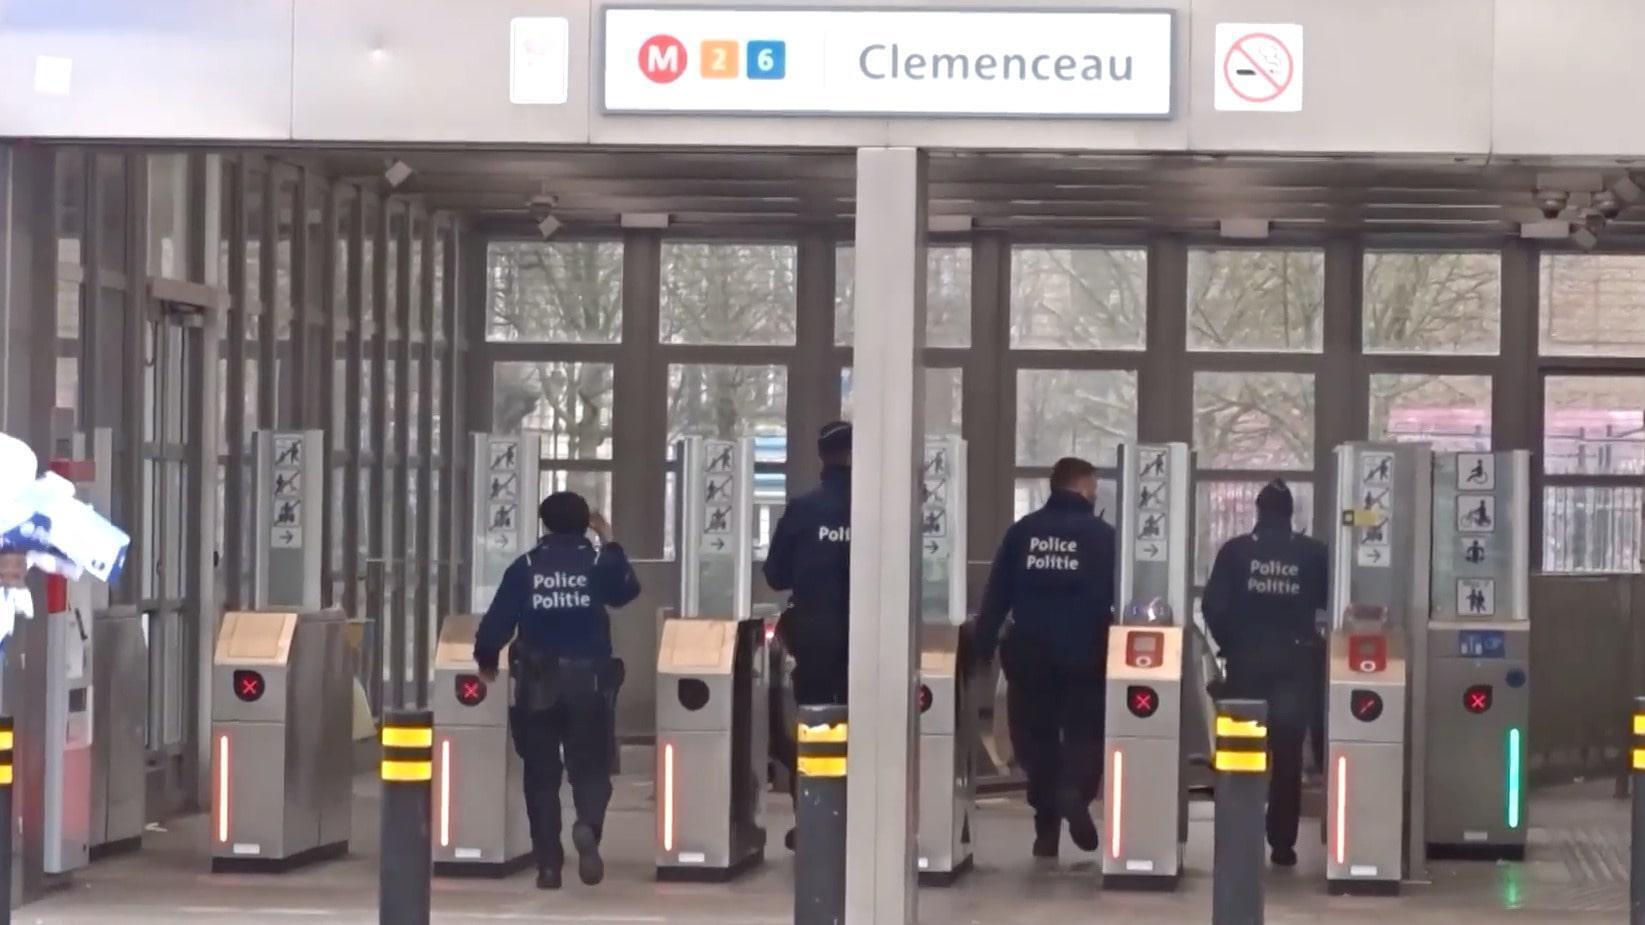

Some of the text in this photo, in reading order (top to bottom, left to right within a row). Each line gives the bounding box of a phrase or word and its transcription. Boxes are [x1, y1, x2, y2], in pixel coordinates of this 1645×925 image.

[648, 43, 1133, 81] M 2 6 Clemenceau
[1029, 536, 1078, 553] Police
[1026, 554, 1080, 571] Politie
[1250, 559, 1299, 576] Police
[533, 571, 588, 590] Police
[1247, 577, 1301, 594] Politie
[532, 590, 591, 610] Politie
